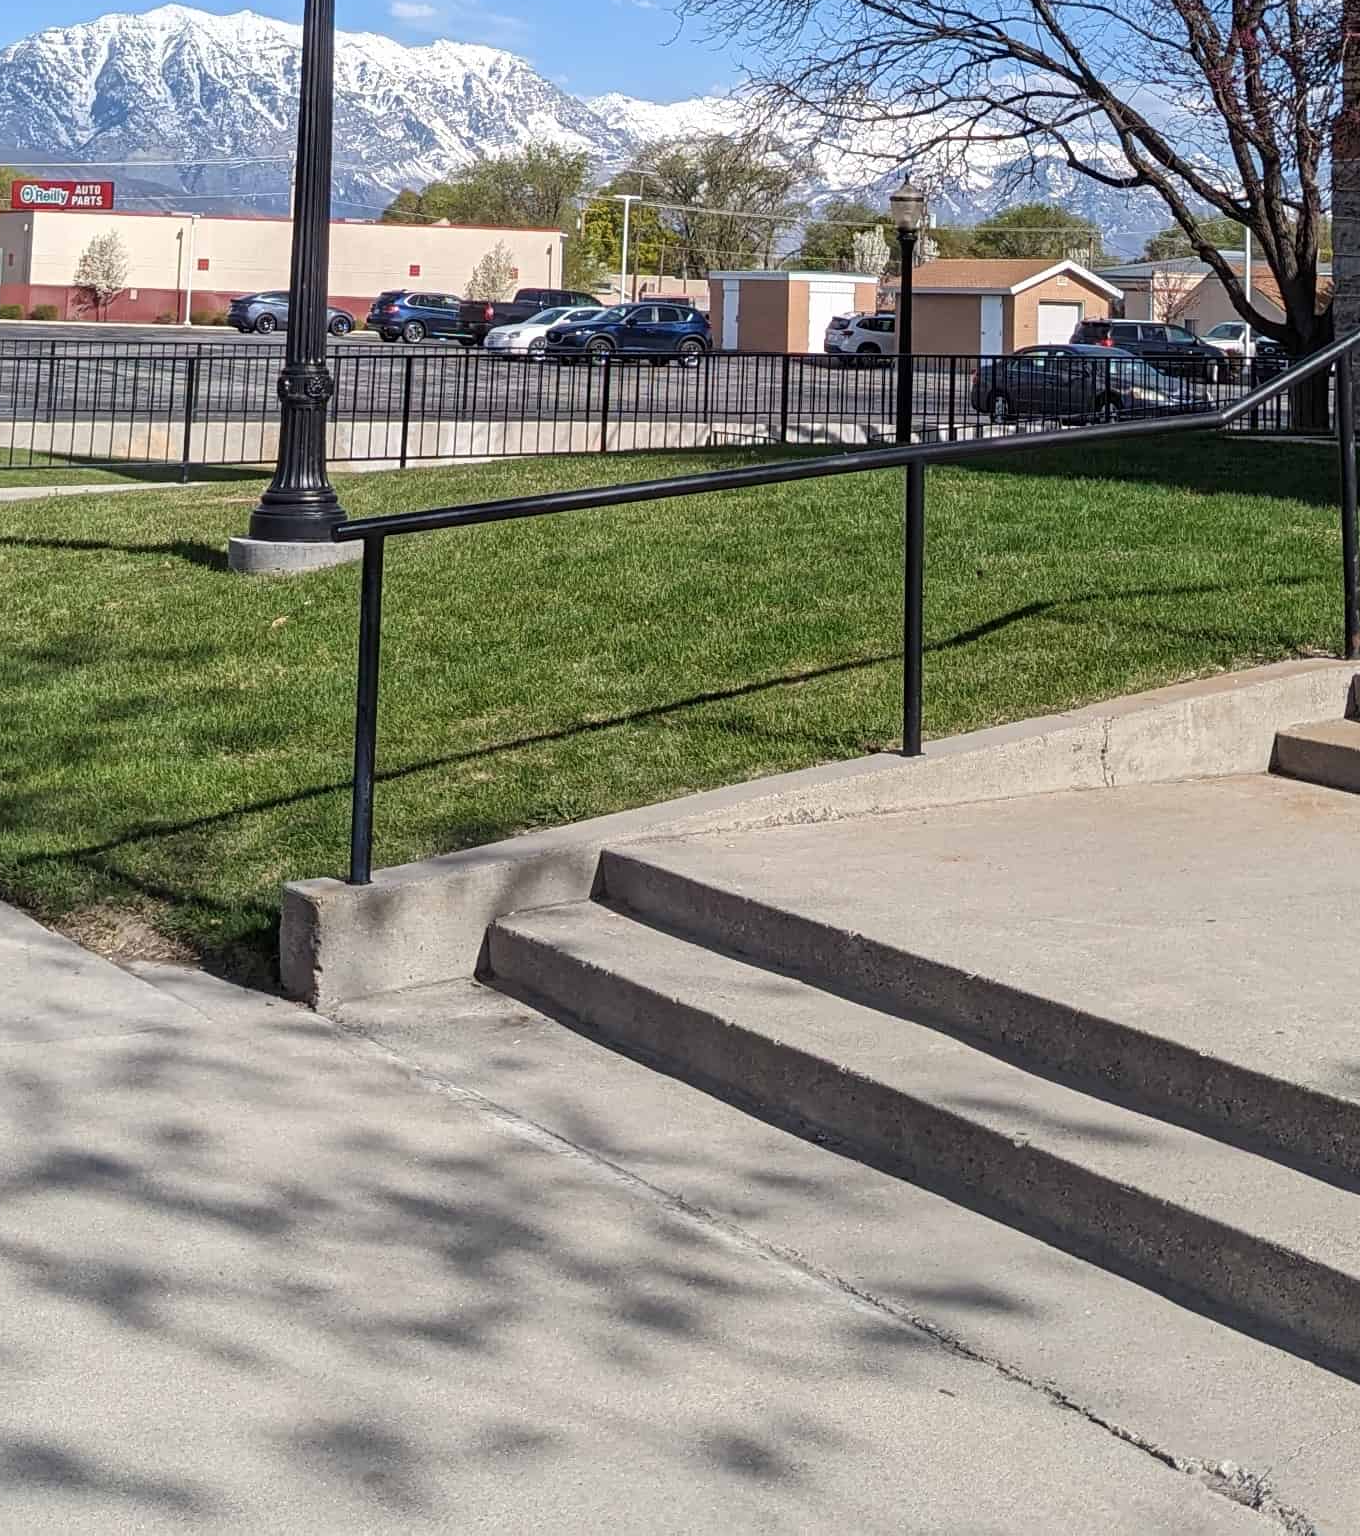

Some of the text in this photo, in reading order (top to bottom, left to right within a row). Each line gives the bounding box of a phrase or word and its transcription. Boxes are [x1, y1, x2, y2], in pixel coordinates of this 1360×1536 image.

[21, 185, 69, 205] O'Reilly
[75, 185, 101, 195] AUTO
[72, 196, 103, 206] PARTS
